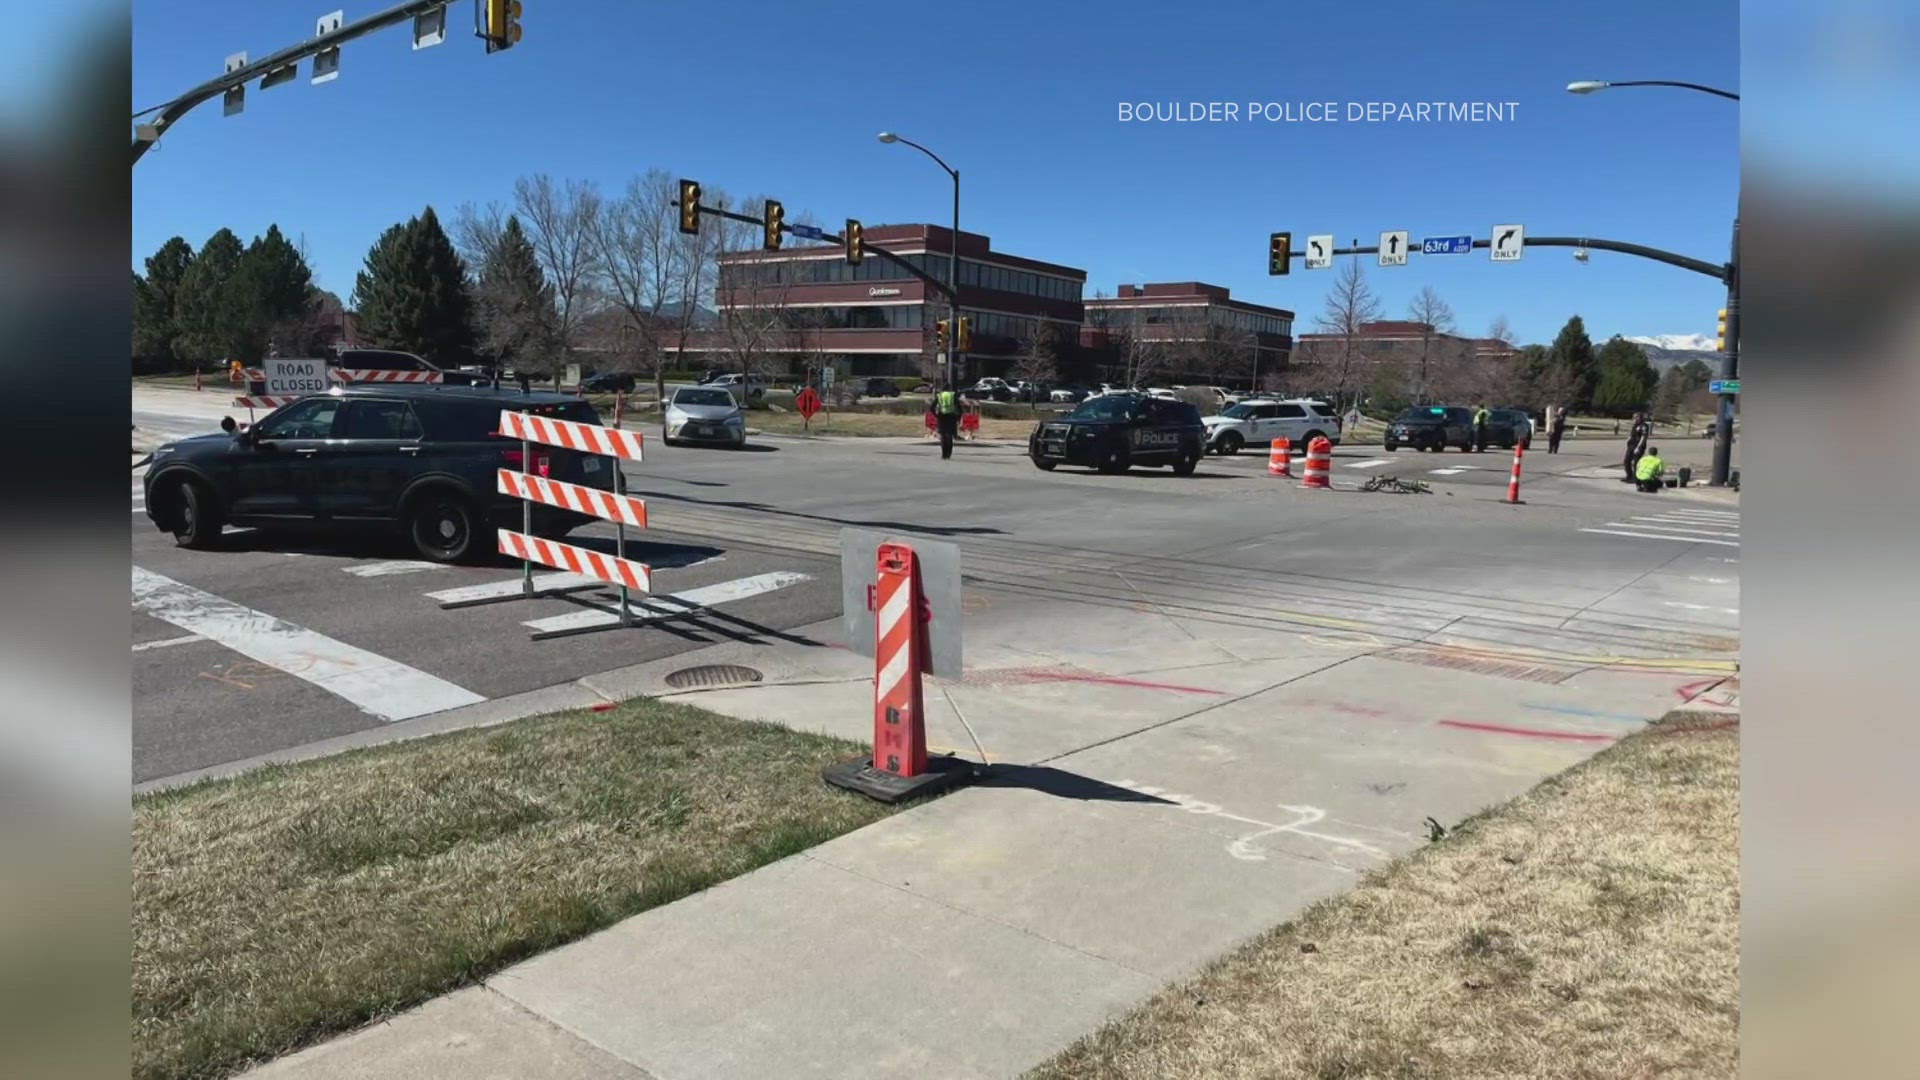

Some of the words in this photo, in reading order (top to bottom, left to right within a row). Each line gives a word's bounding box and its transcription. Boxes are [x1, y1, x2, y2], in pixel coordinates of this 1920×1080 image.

[1424, 239, 1450, 253] 63rd
[1381, 255, 1404, 265] ONLY
[1493, 251, 1518, 259] ONLY
[1308, 259, 1327, 267] ONLY
[277, 363, 314, 376] ROAD
[271, 379, 323, 391] CLOSED
[1142, 433, 1179, 445] POLICE
